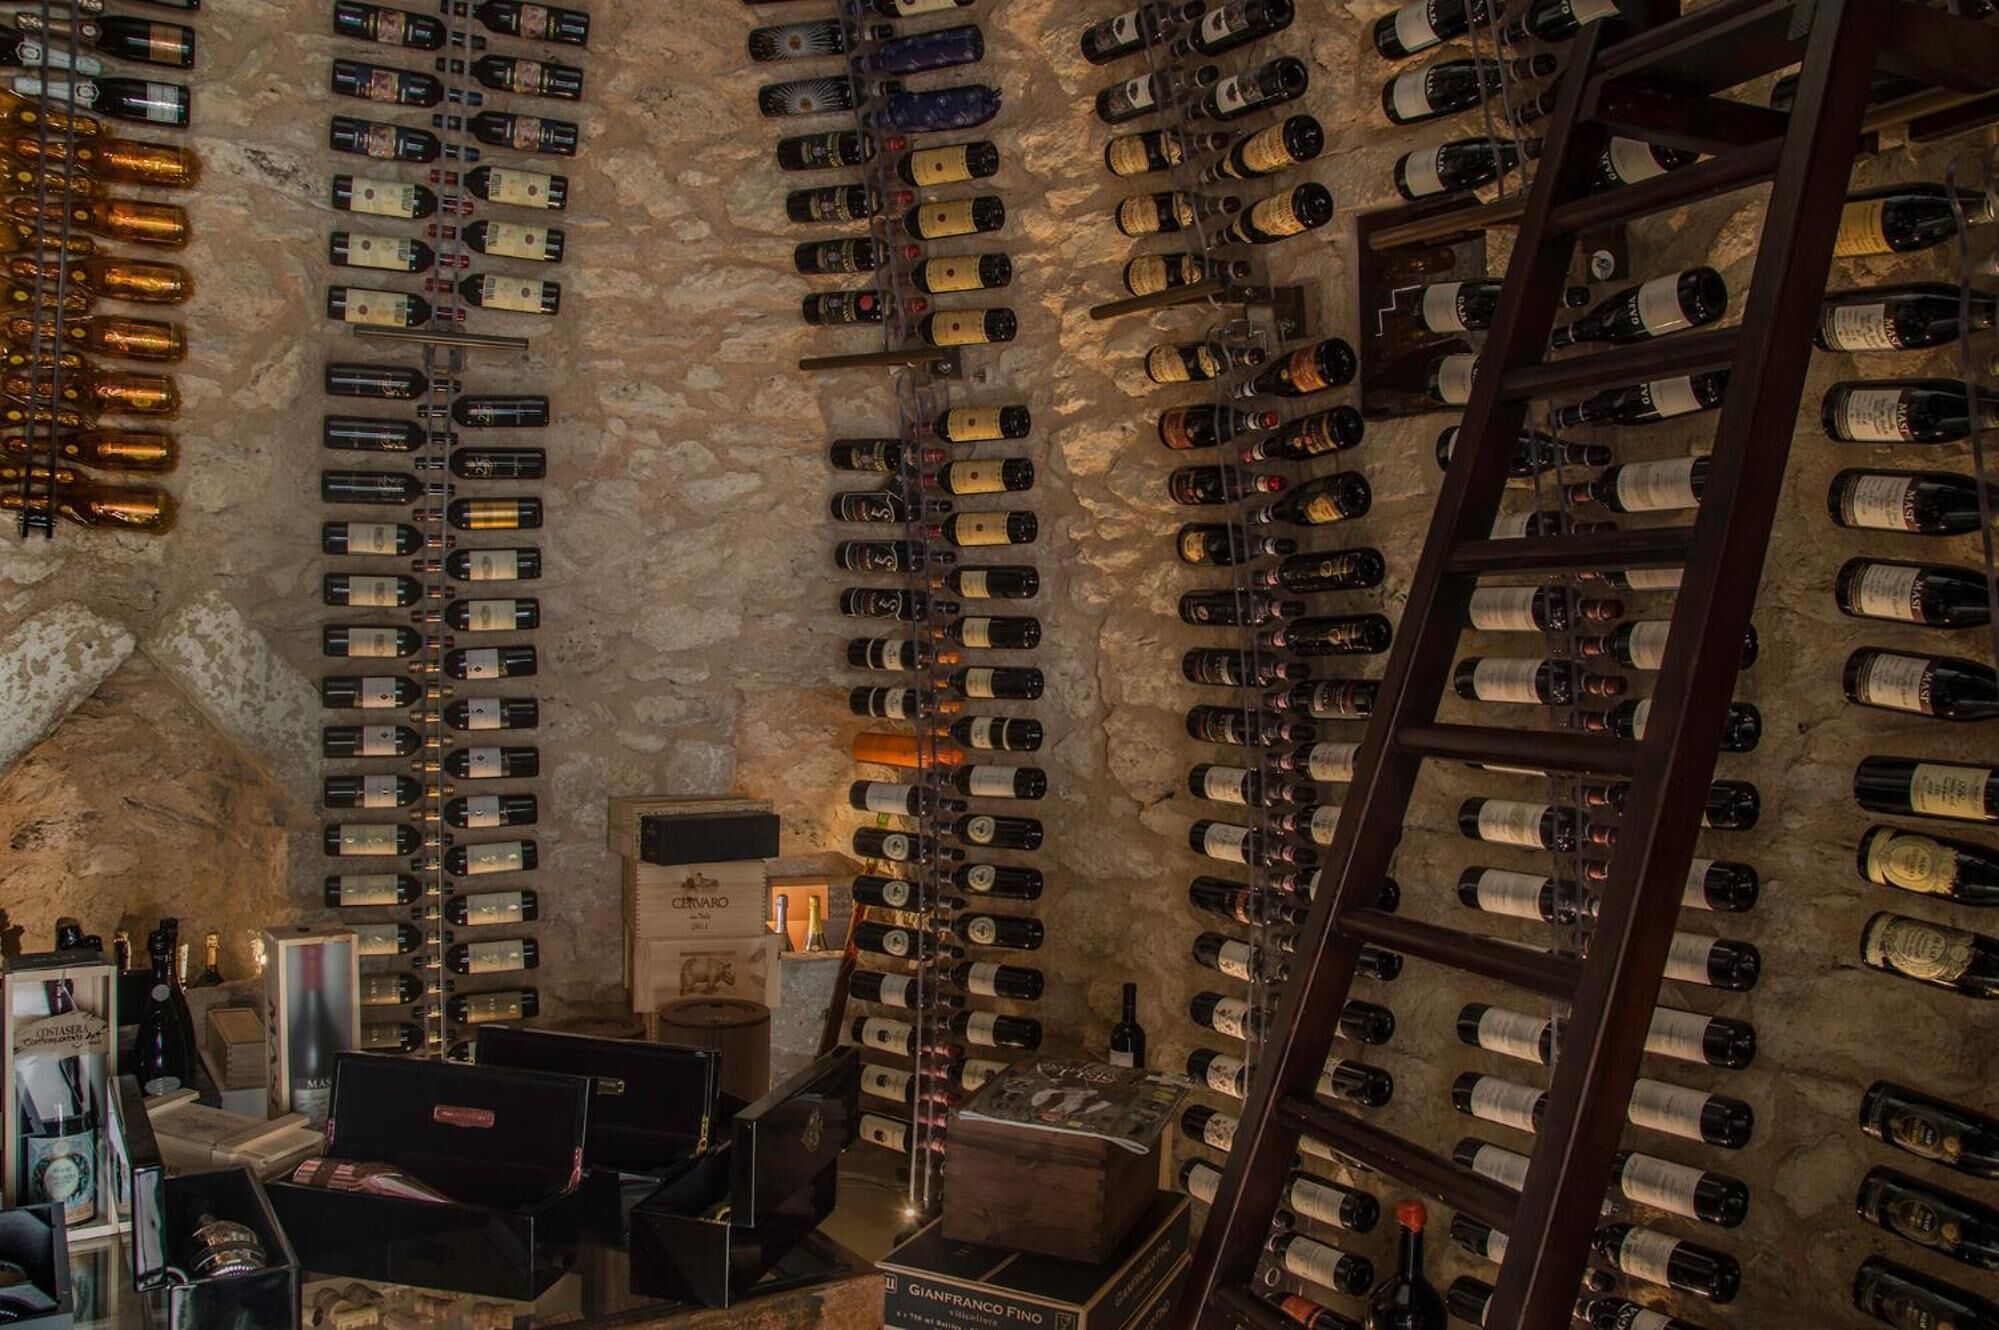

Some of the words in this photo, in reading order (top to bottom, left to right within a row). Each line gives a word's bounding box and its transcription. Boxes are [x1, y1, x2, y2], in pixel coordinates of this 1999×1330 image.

[1456, 295, 1467, 323] GAJA
[1628, 295, 1640, 326] GAJA
[1638, 383, 1650, 405] GAJ
[671, 896, 730, 909] CERVARO
[306, 1079, 332, 1088] MAS
[908, 1283, 1004, 1316] GIANFRANCO
[1006, 1305, 1043, 1325] FINO
